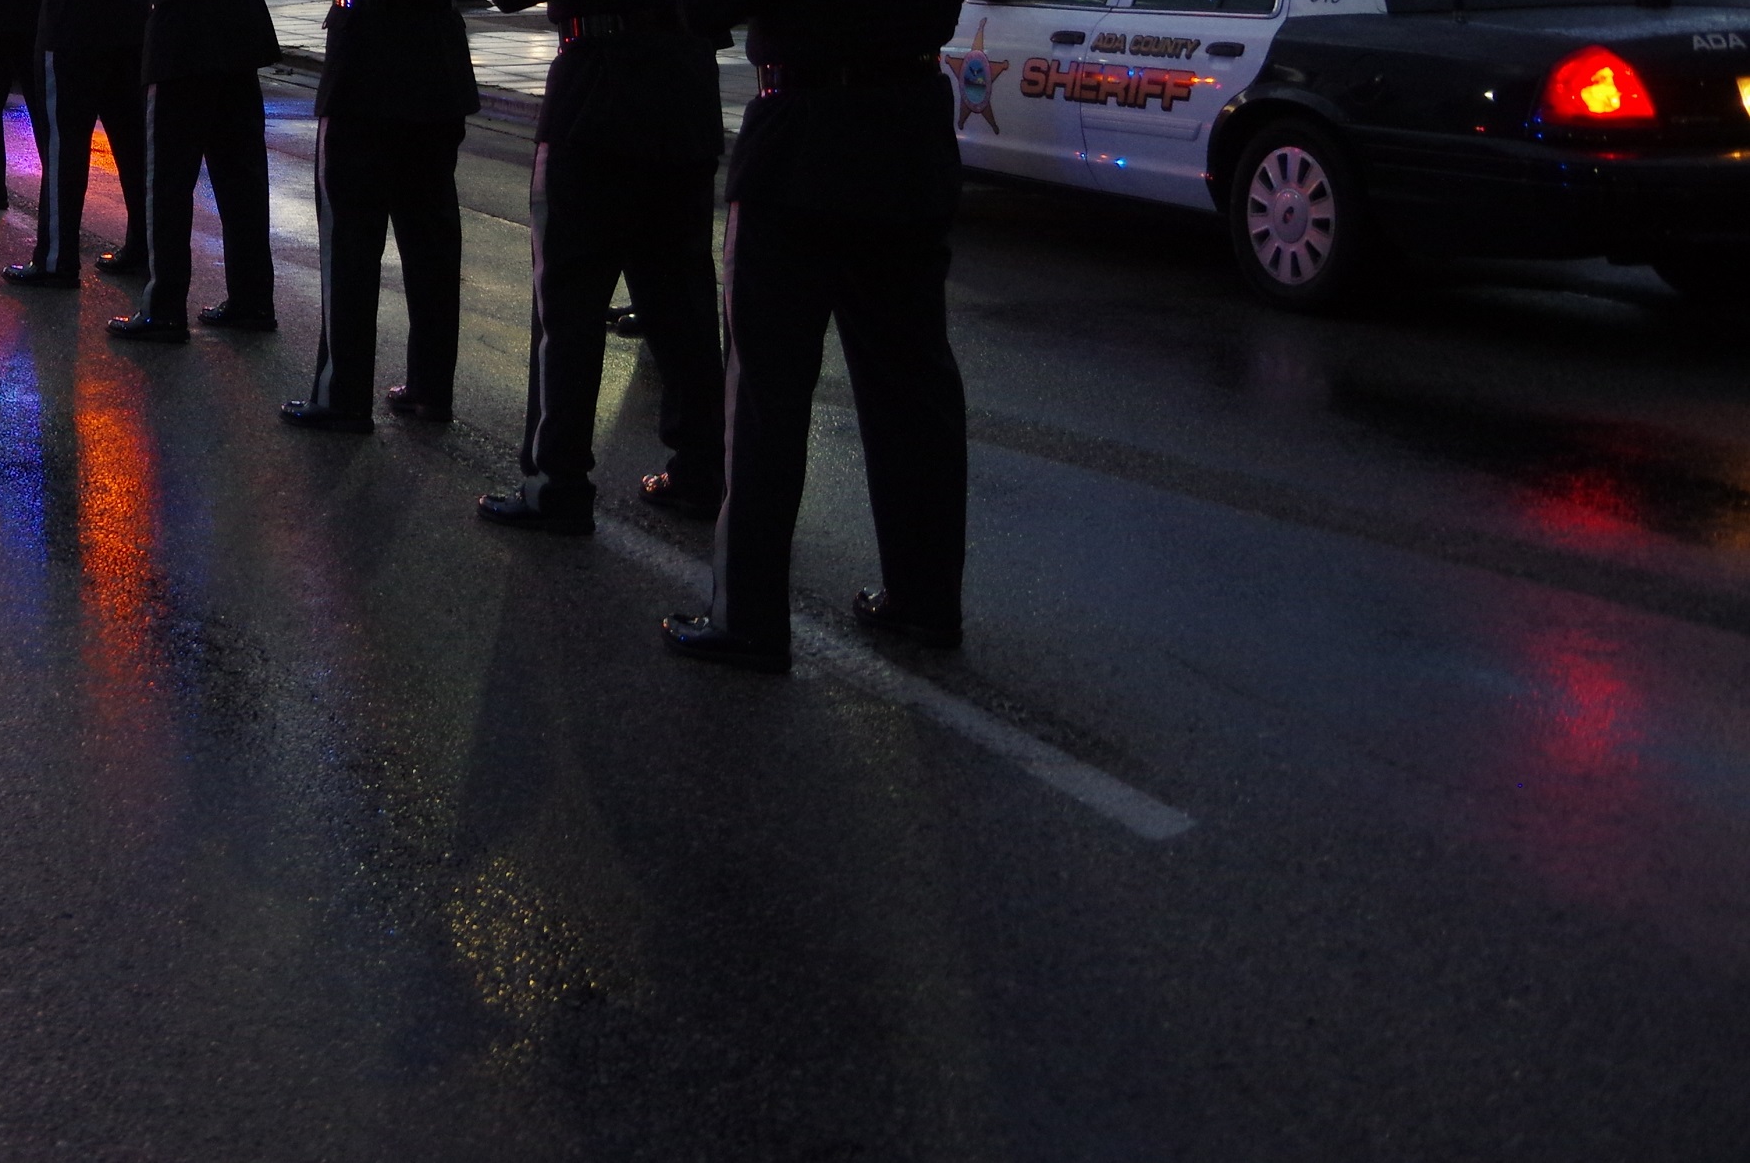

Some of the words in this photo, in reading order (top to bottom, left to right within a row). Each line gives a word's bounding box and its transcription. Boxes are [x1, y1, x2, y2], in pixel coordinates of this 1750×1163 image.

[1091, 33, 1126, 54] ADA
[1129, 34, 1201, 59] COUNTY
[1692, 33, 1748, 51] ADA
[1020, 57, 1196, 111] SHERIFF
